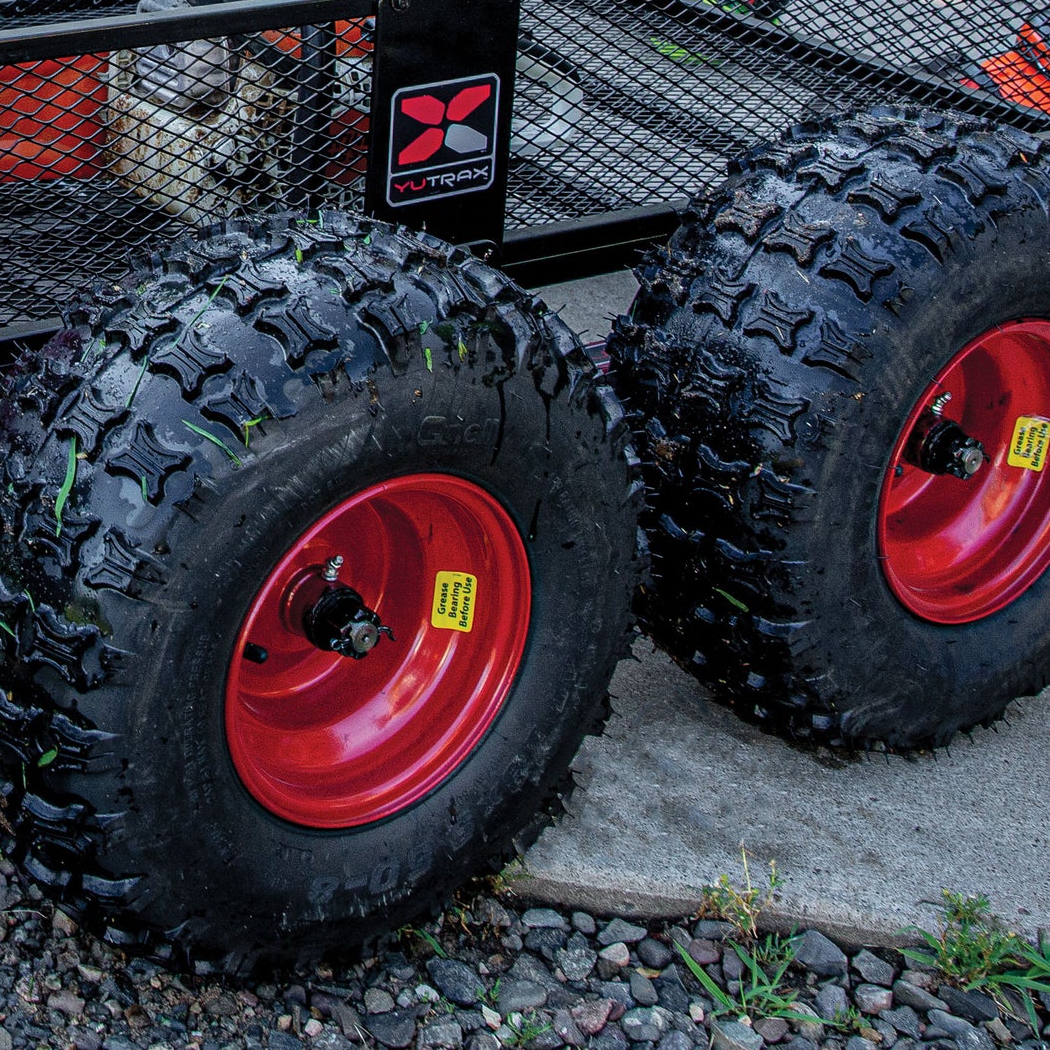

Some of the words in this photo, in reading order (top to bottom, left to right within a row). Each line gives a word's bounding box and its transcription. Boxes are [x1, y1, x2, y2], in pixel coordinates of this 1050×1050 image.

[394, 166, 489, 193] YUTRAX
[1023, 426, 1038, 458] Bearing
[1031, 439, 1045, 467] Before
[1038, 423, 1048, 439] Use
[437, 582, 449, 615] Grease
[448, 581, 463, 618] Bearing
[463, 577, 473, 594] Use
[458, 595, 471, 628] Before
